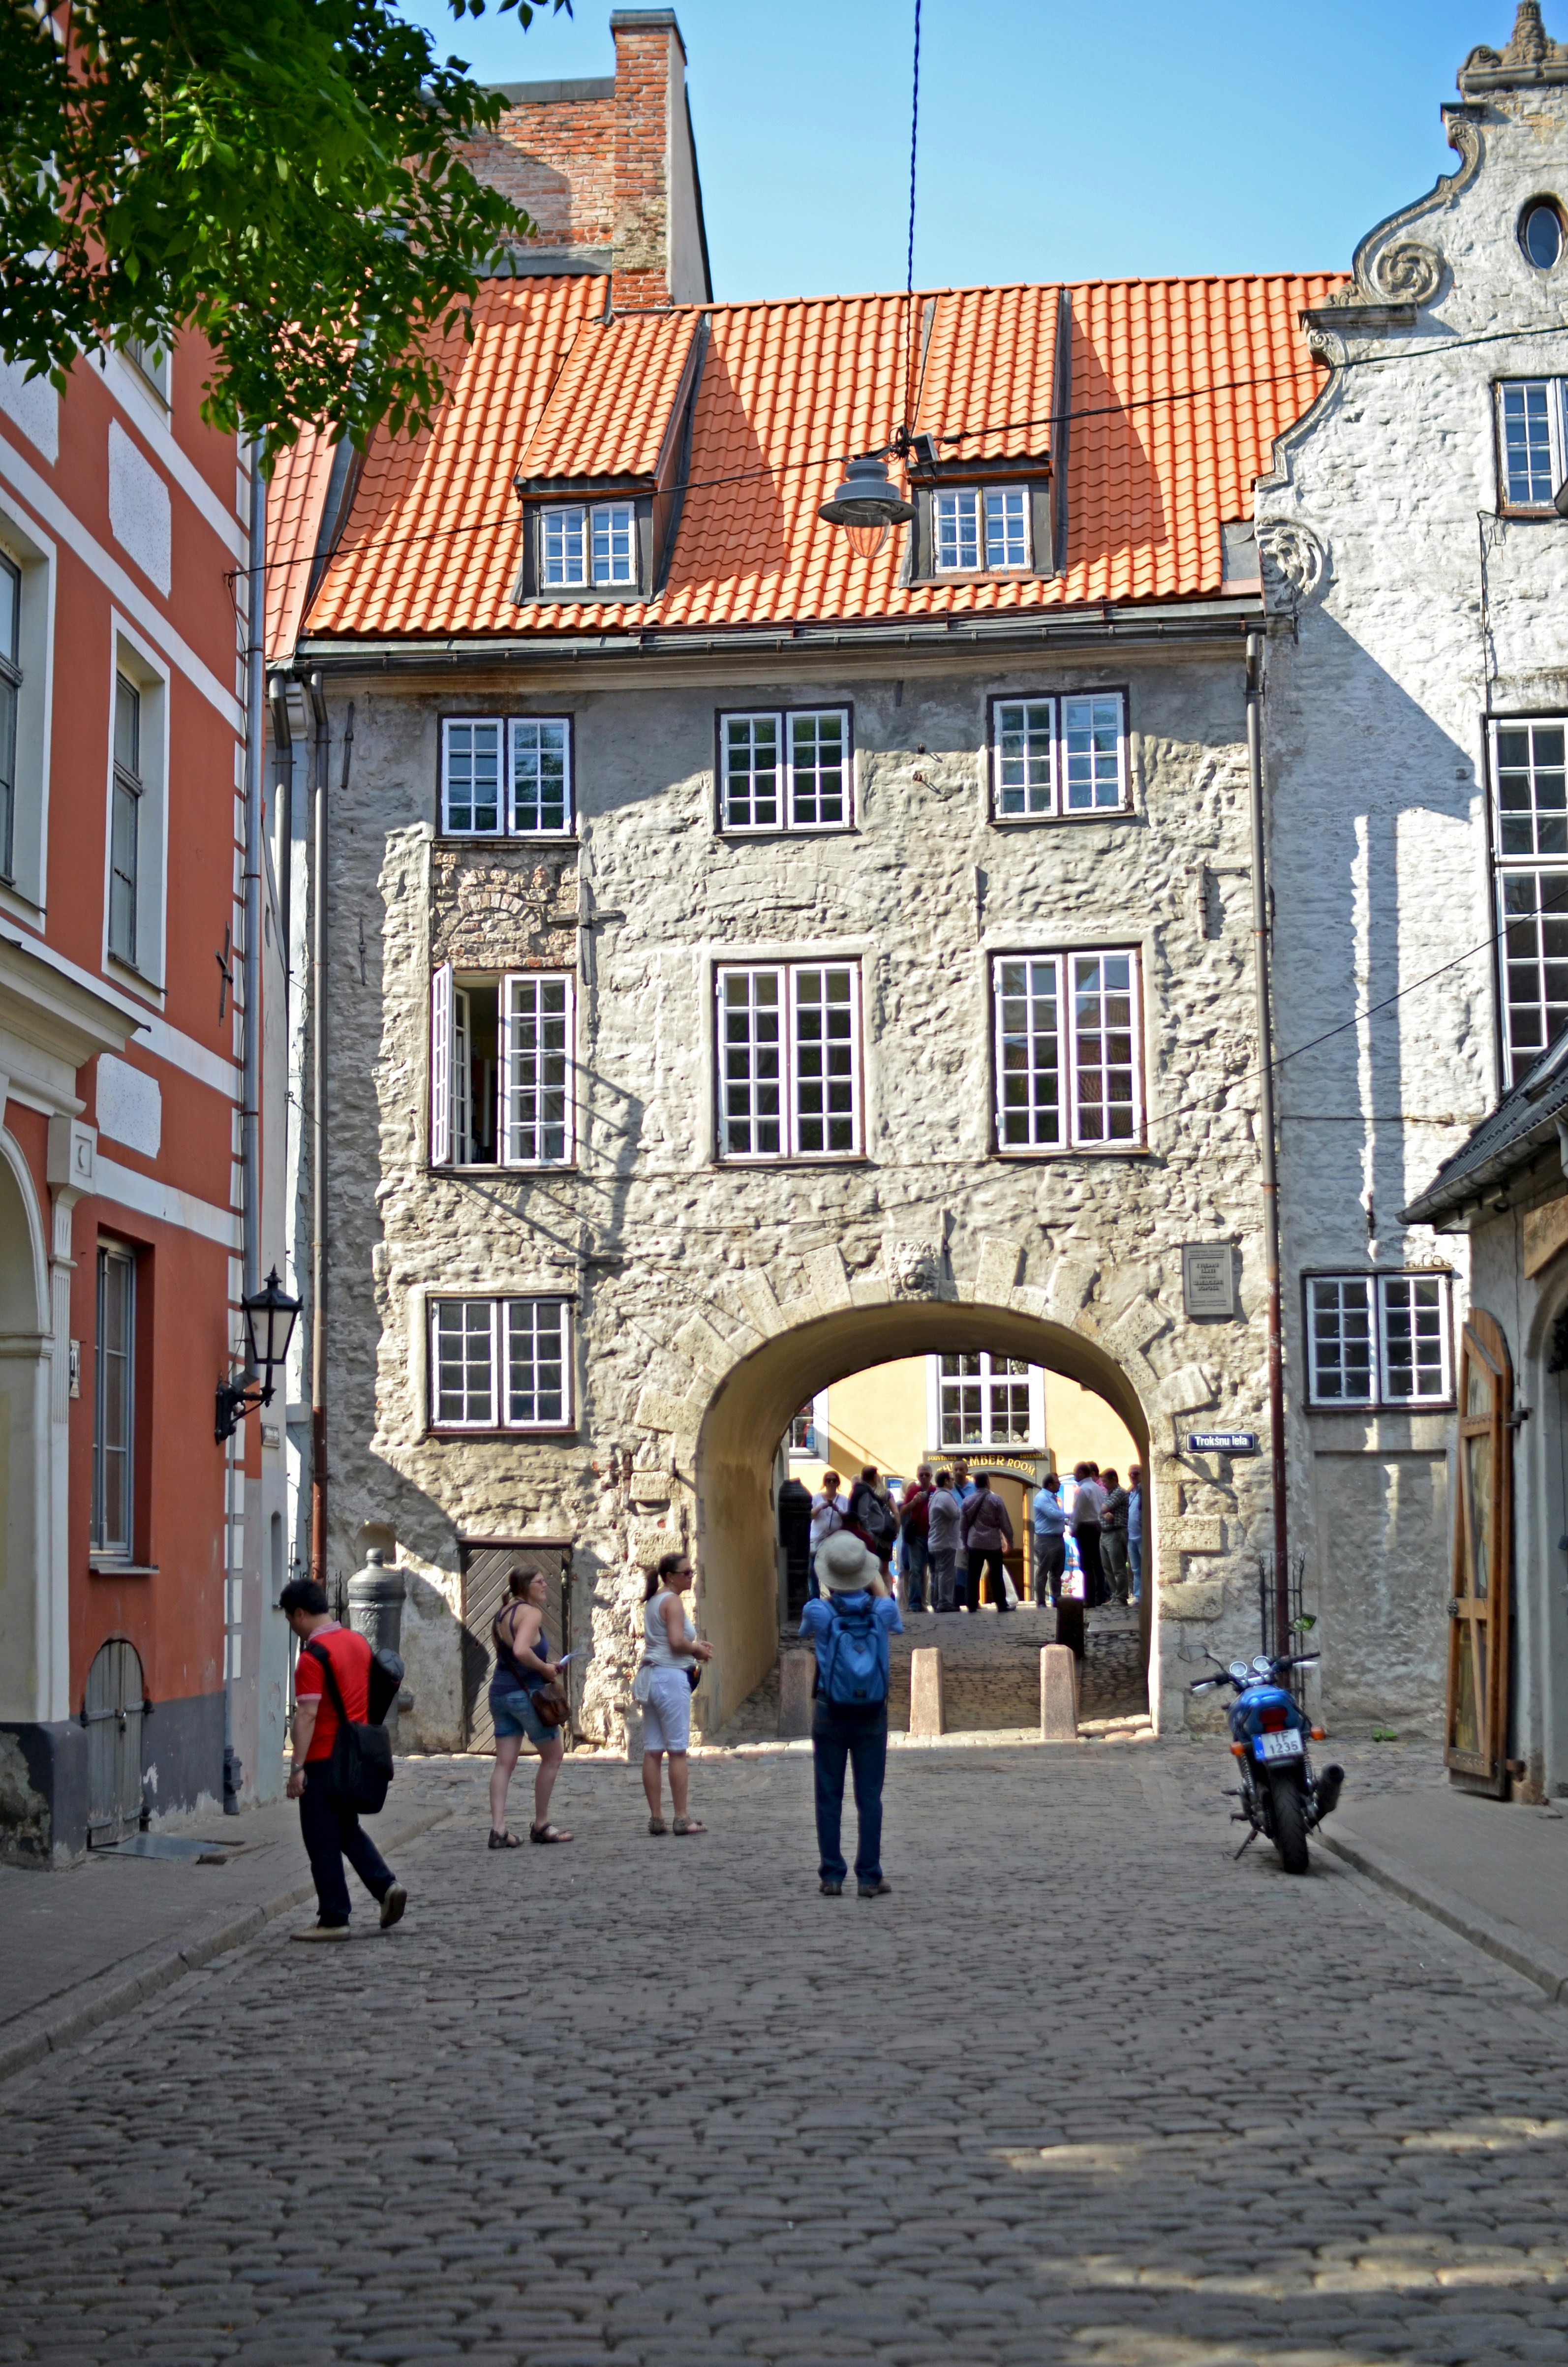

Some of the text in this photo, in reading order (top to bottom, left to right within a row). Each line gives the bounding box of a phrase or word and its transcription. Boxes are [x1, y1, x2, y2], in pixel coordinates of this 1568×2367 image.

[1232, 1436, 1247, 1445] iela
[1007, 1458, 1035, 1476] ROOM
[1272, 1731, 1289, 1742] TF
[1270, 1740, 1298, 1754] 1235
